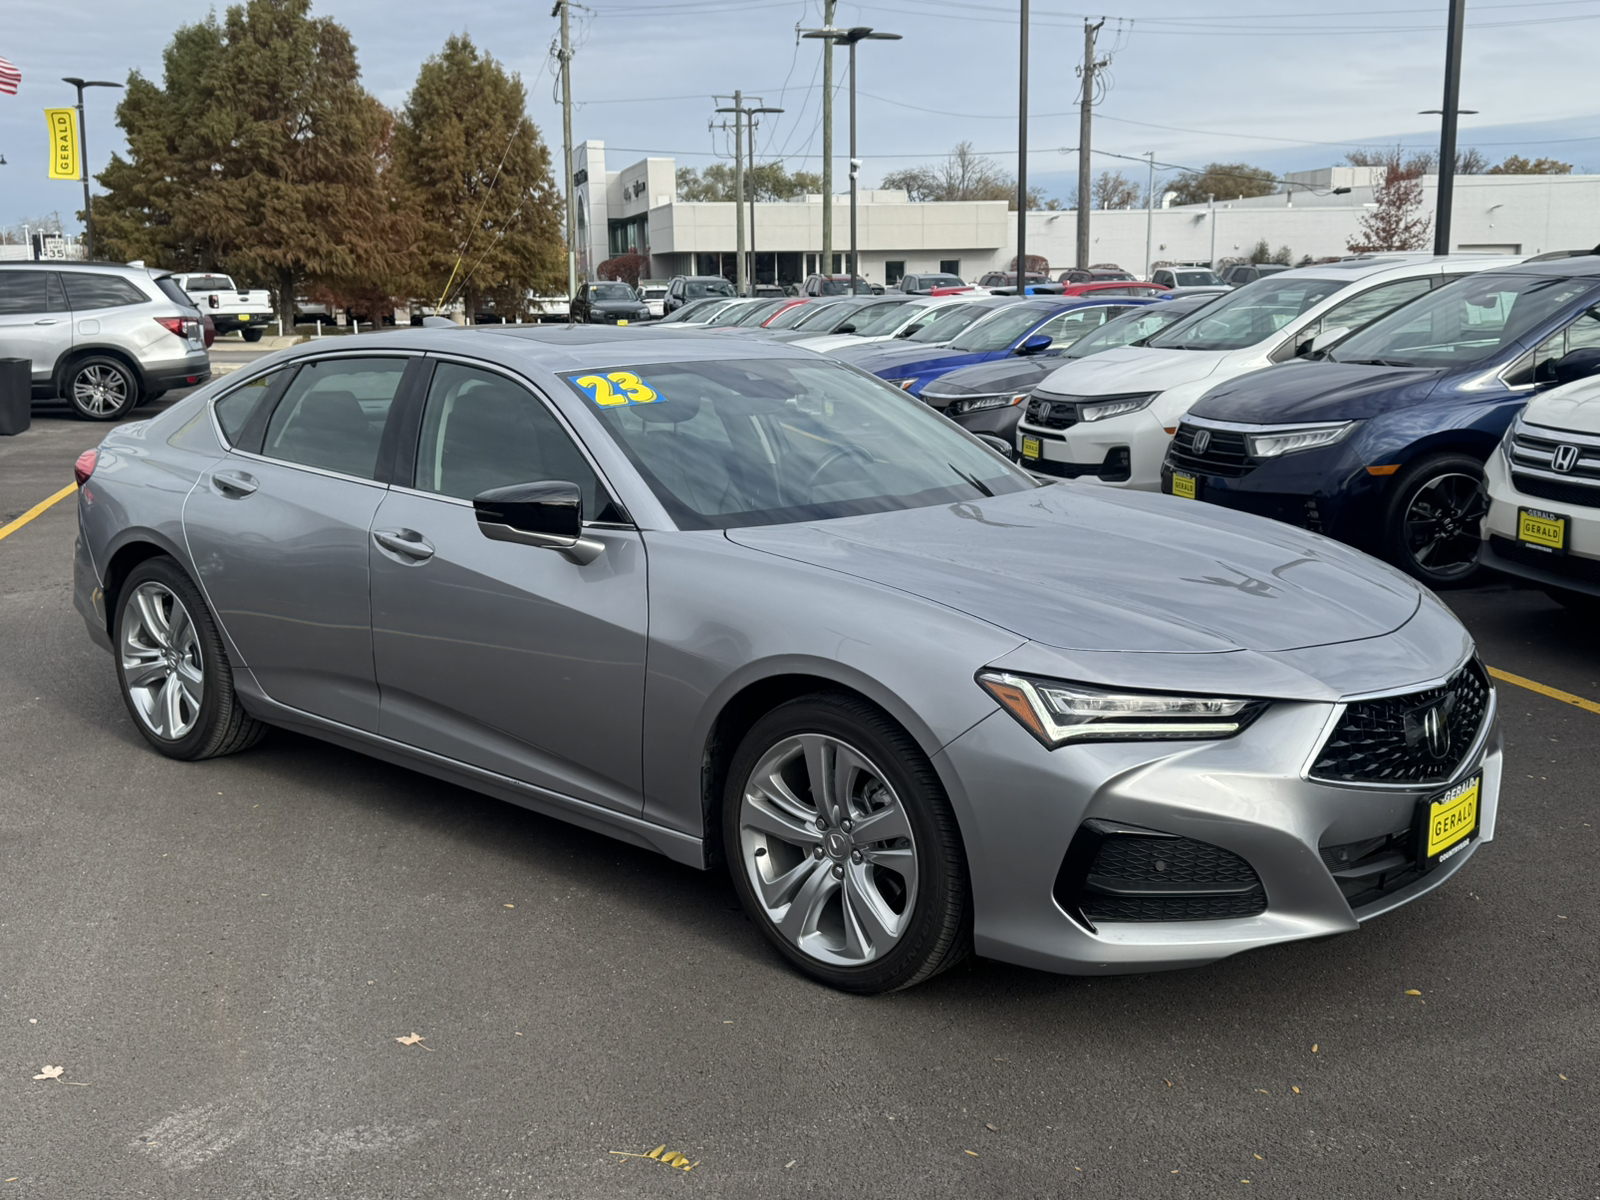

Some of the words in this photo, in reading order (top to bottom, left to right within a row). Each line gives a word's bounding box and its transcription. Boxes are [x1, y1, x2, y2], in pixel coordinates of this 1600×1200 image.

[58, 117, 69, 170] GERALD
[49, 249, 64, 258] 35
[576, 371, 658, 406] 23
[1528, 509, 1555, 520] GERALD
[1525, 523, 1558, 538] GERALD
[1435, 802, 1473, 836] GERALD
